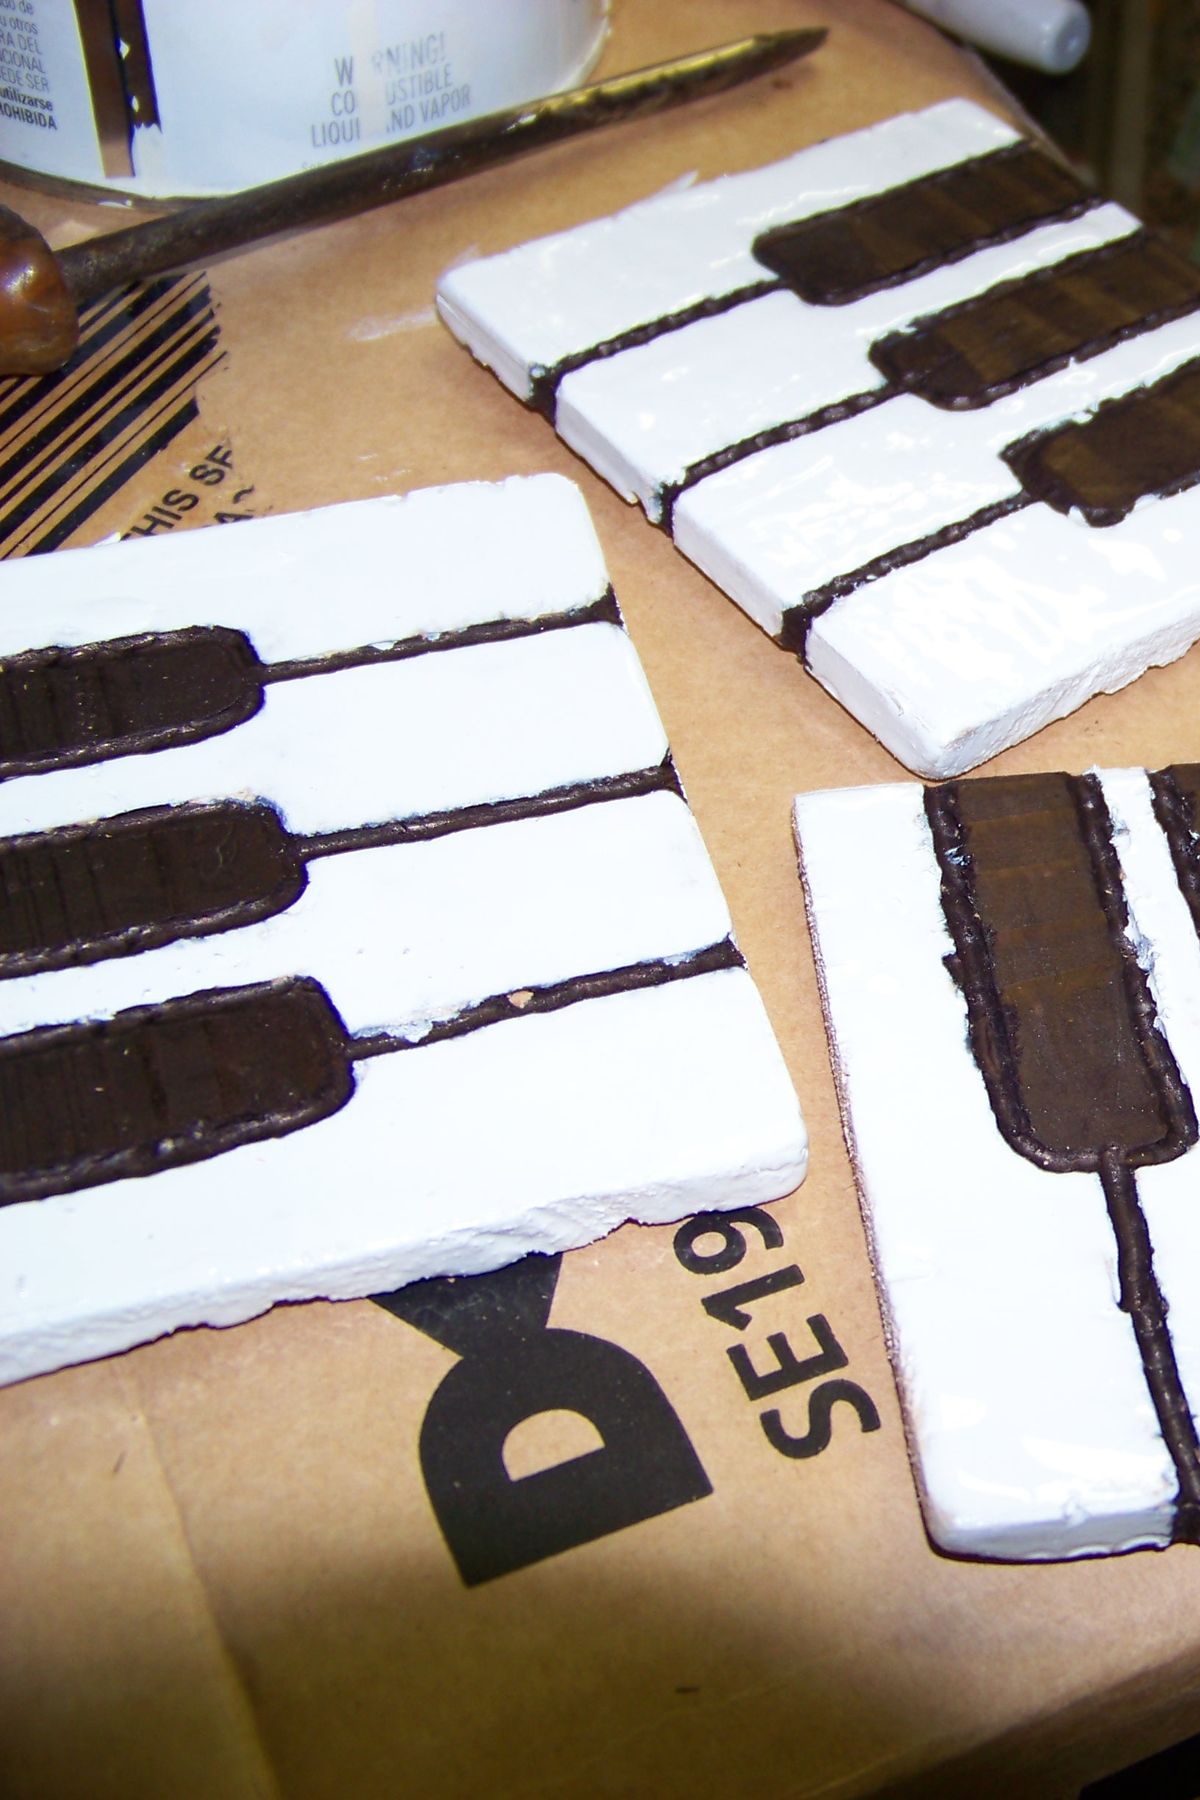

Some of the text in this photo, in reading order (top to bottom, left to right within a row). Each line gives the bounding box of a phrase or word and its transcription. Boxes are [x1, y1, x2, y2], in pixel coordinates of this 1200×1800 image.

[9, 17, 38, 35] otros
[18, 33, 43, 55] DEL
[0, 67, 50, 93] EDE SER
[334, 31, 446, 87] WRNING!
[311, 83, 472, 148] LIQUI ND VAPOR
[331, 63, 453, 117] COUSTIBLE
[672, 1206, 882, 1460] SE19
